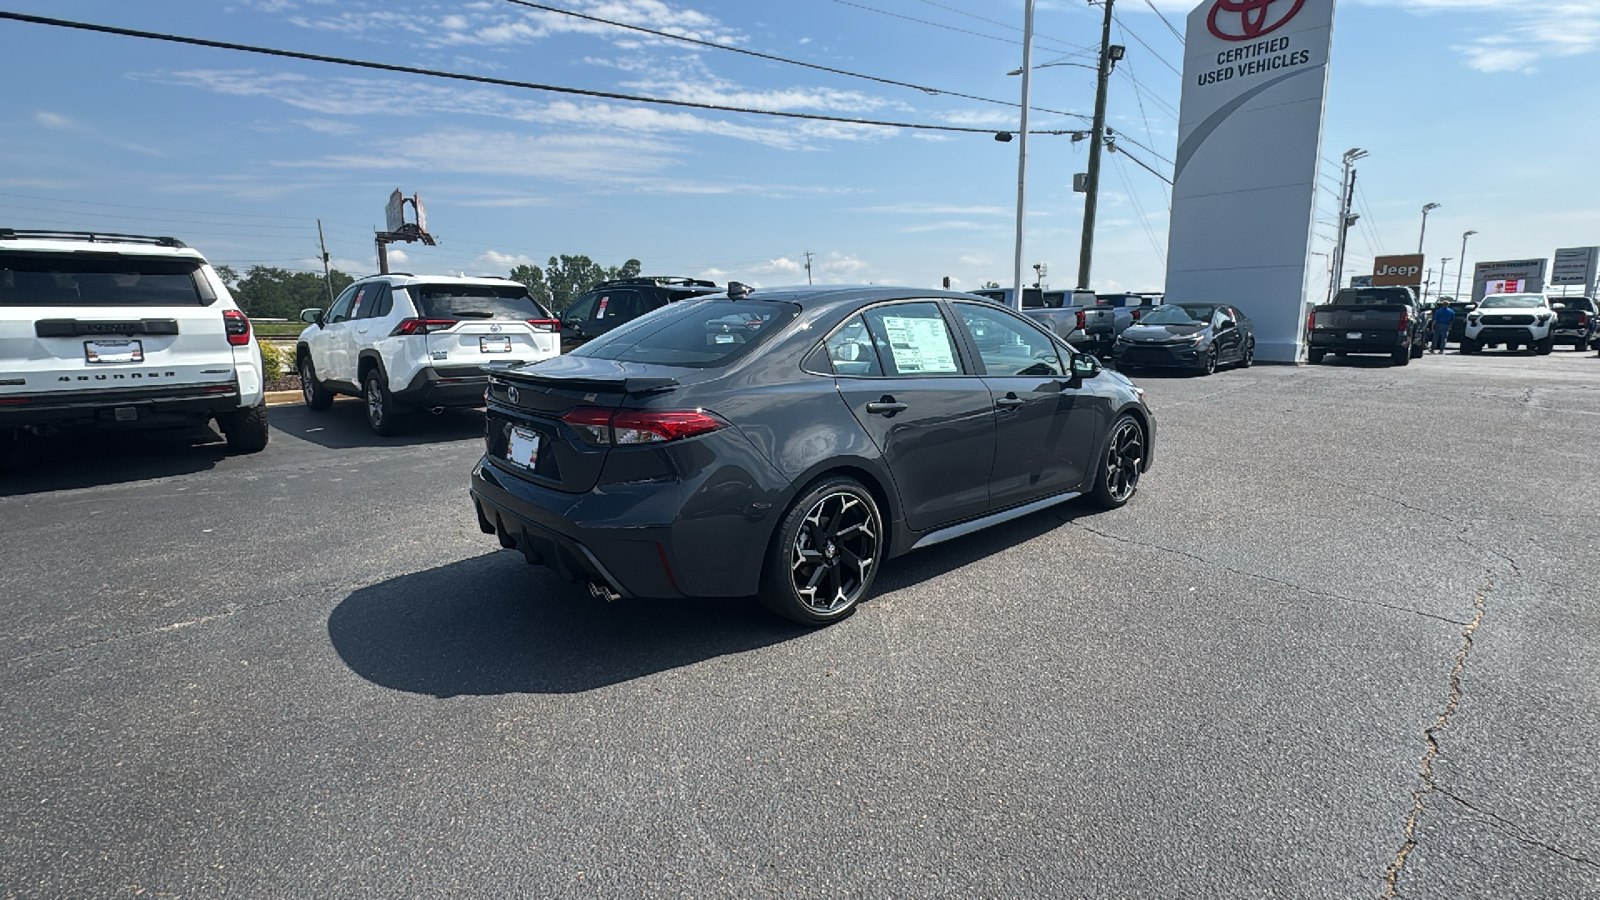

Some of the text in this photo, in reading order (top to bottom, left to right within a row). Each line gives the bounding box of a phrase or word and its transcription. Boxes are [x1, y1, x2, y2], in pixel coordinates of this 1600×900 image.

[1217, 36, 1289, 65] CERTIFIED
[1197, 49, 1309, 86] USED VEHICLES
[1376, 263, 1419, 278] Jeep
